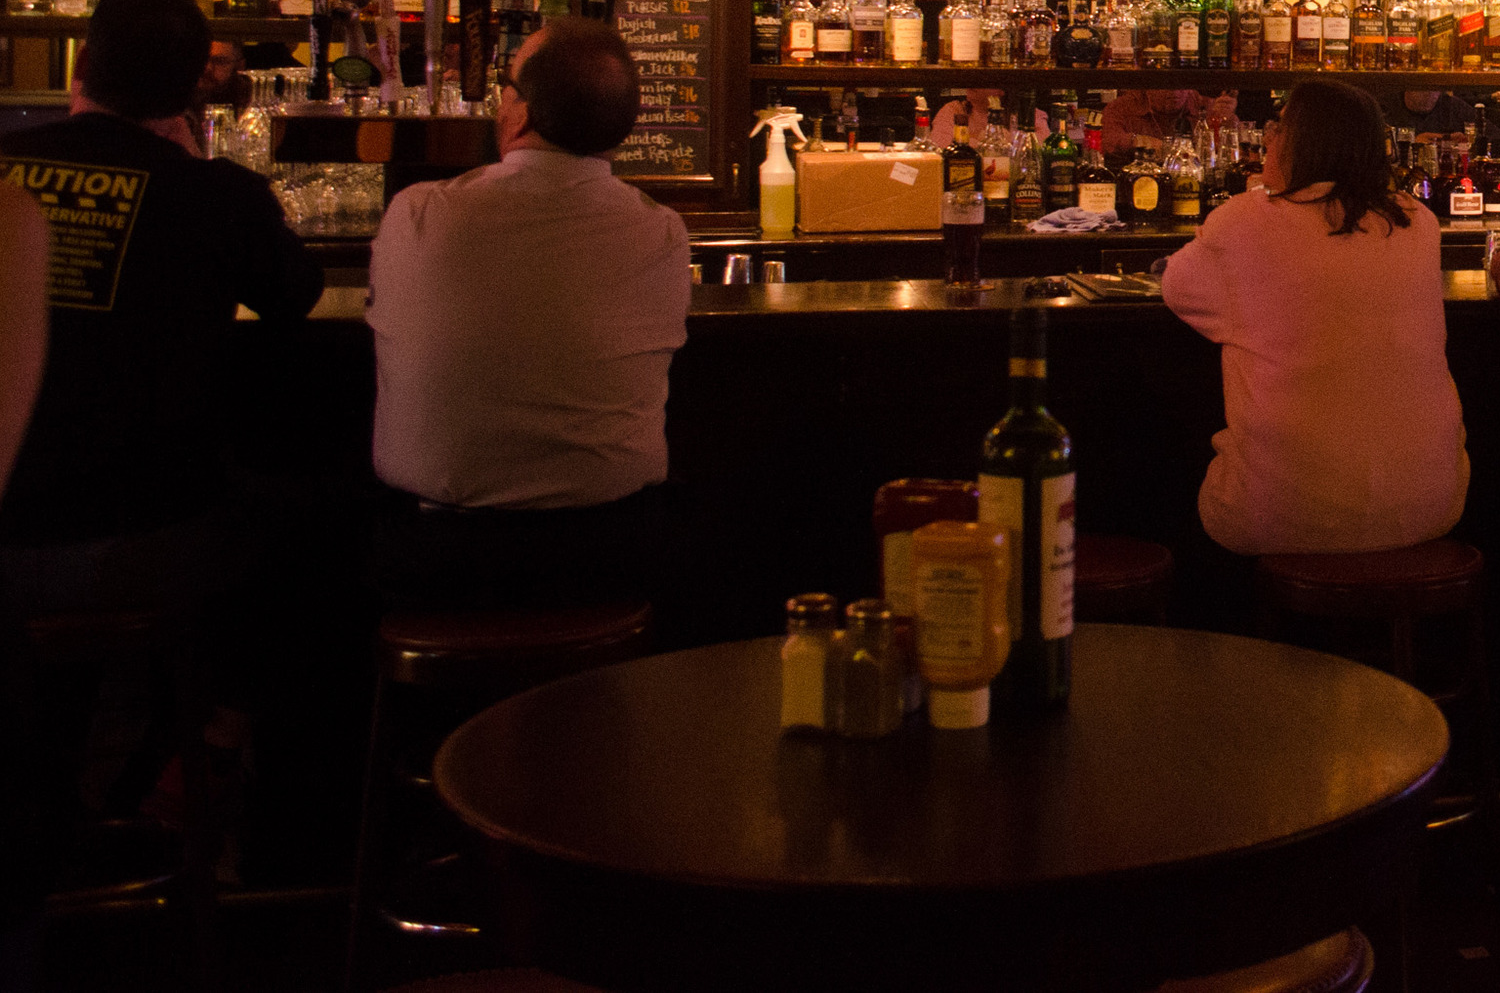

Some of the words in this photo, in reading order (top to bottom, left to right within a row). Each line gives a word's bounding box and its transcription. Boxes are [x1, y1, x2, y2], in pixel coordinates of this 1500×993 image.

[621, 133, 673, 147] unders
[0, 163, 139, 199] AUTION
[40, 206, 126, 230] SERVATIVE
